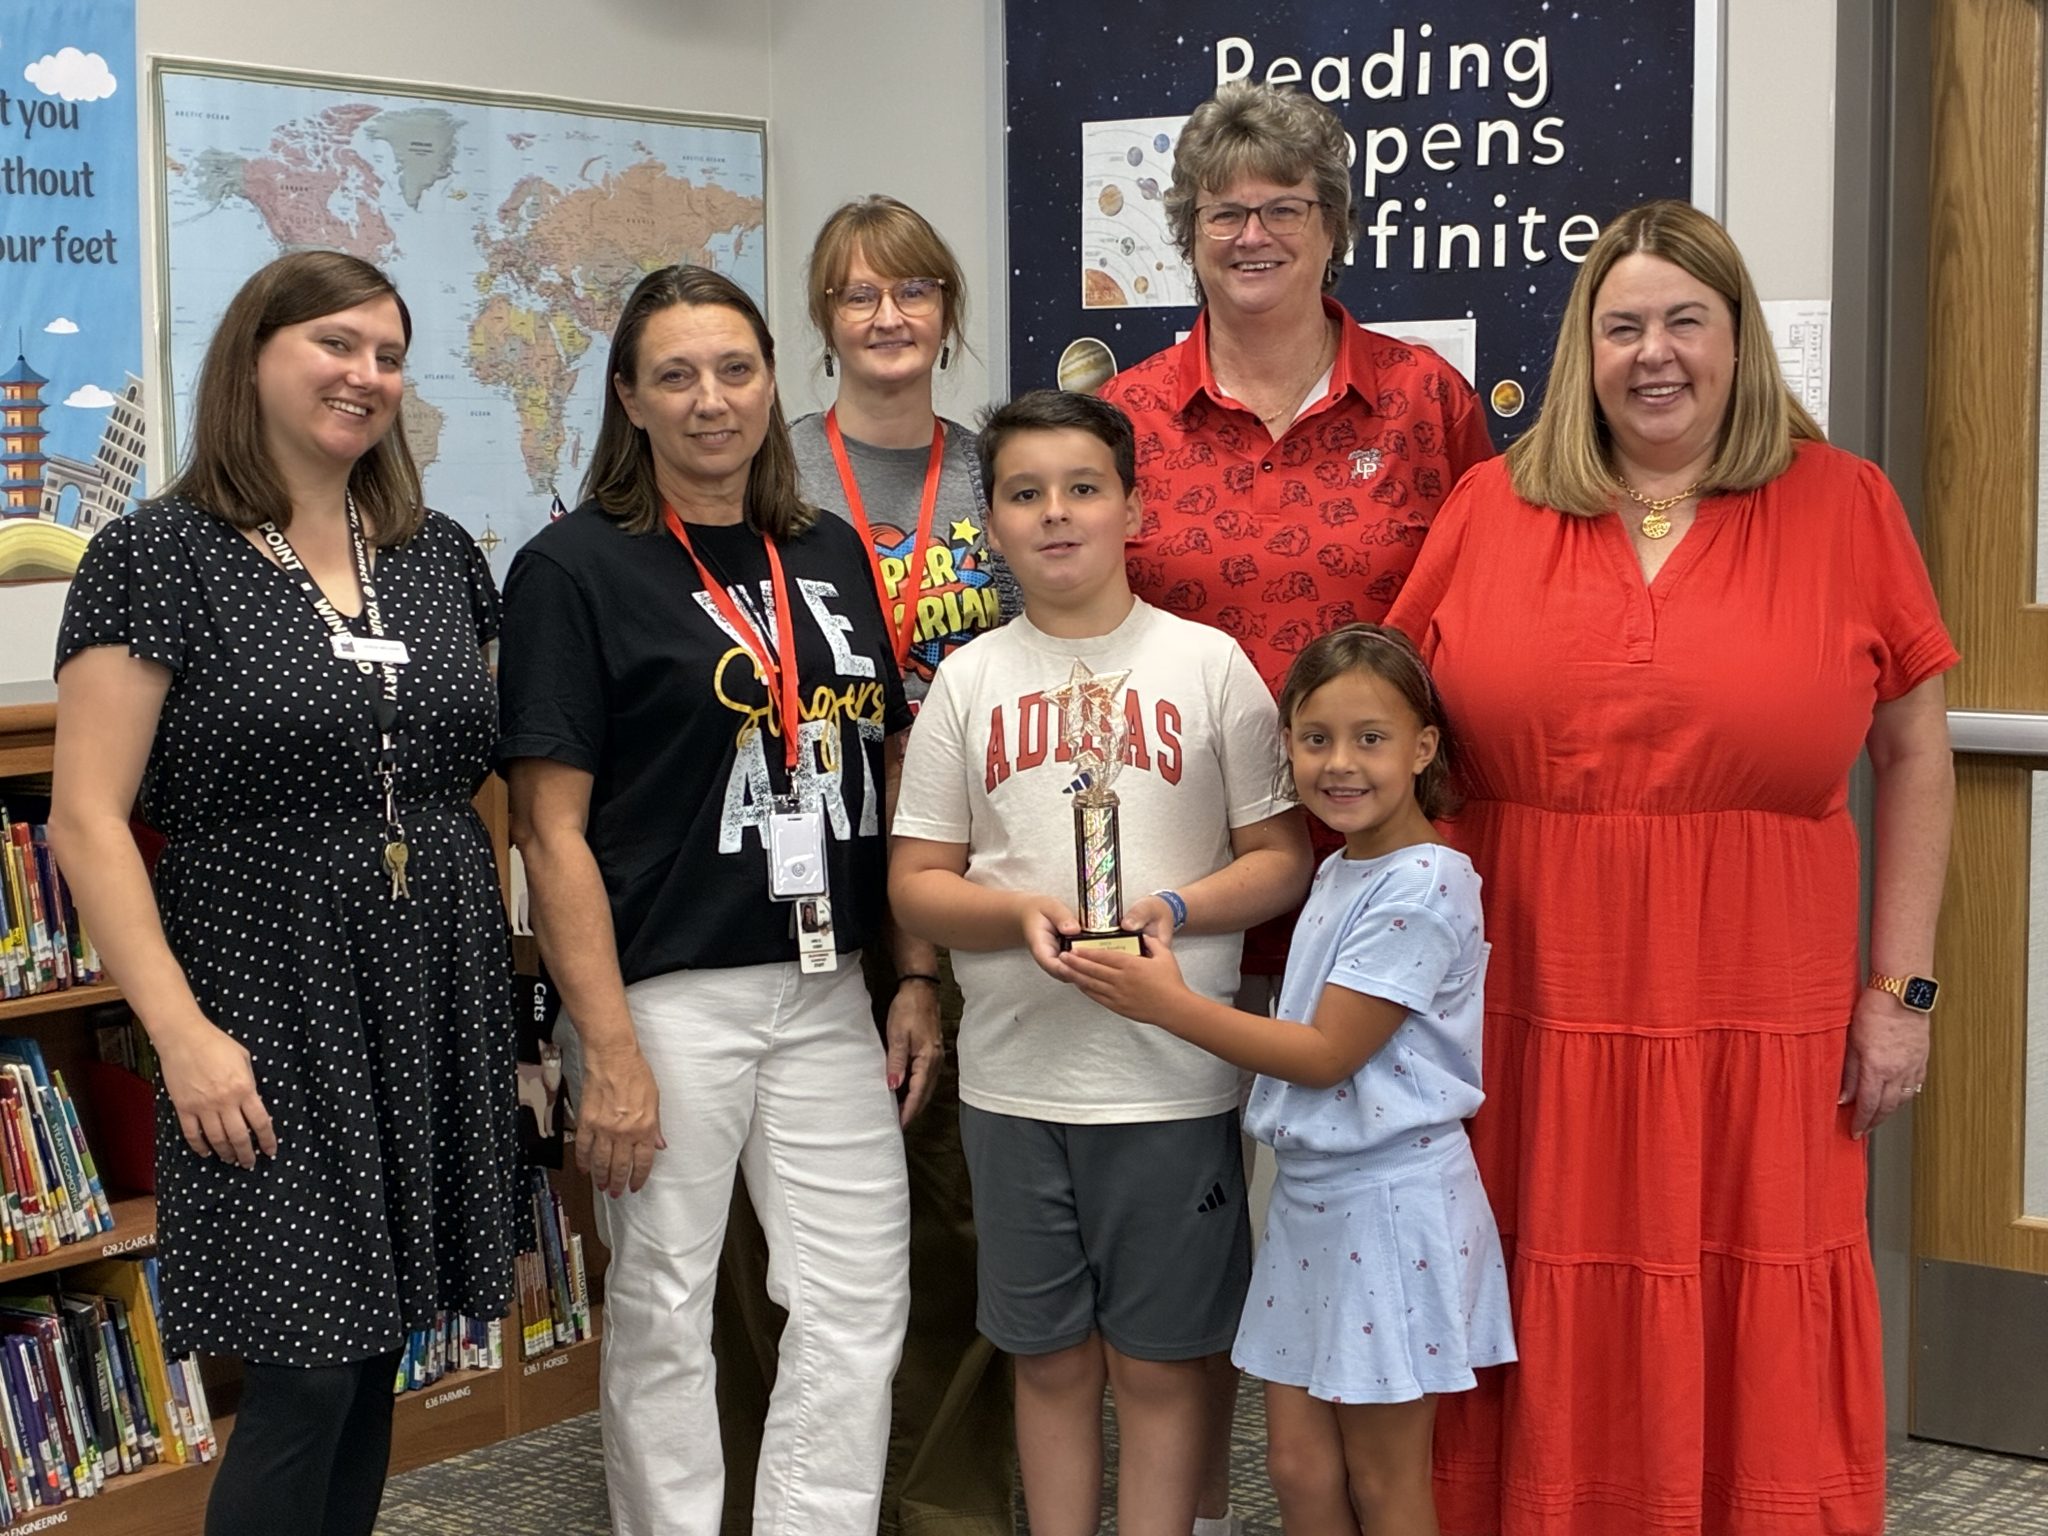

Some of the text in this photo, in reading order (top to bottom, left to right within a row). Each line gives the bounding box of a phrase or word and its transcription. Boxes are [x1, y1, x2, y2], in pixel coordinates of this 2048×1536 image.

[1216, 23, 1547, 108] Reading
[16, 99, 79, 139] you
[0, 155, 95, 198] thout
[1343, 117, 1565, 197] pens
[51, 225, 118, 264] feet
[1344, 194, 1600, 268] finite
[257, 521, 304, 572] POINT
[894, 587, 1001, 643] RIAN
[366, 601, 385, 637] YOUR
[381, 661, 398, 700] ARY!
[534, 983, 547, 1021] Cats
[52, 1123, 65, 1151] STEAM
[60, 1152, 81, 1212] LOCOMOTIVES
[124, 1235, 148, 1250] CARS
[543, 1354, 569, 1370] HORSES
[425, 1386, 471, 1409] 636 FARMING
[10, 1511, 68, 1536] ENGINEERING
